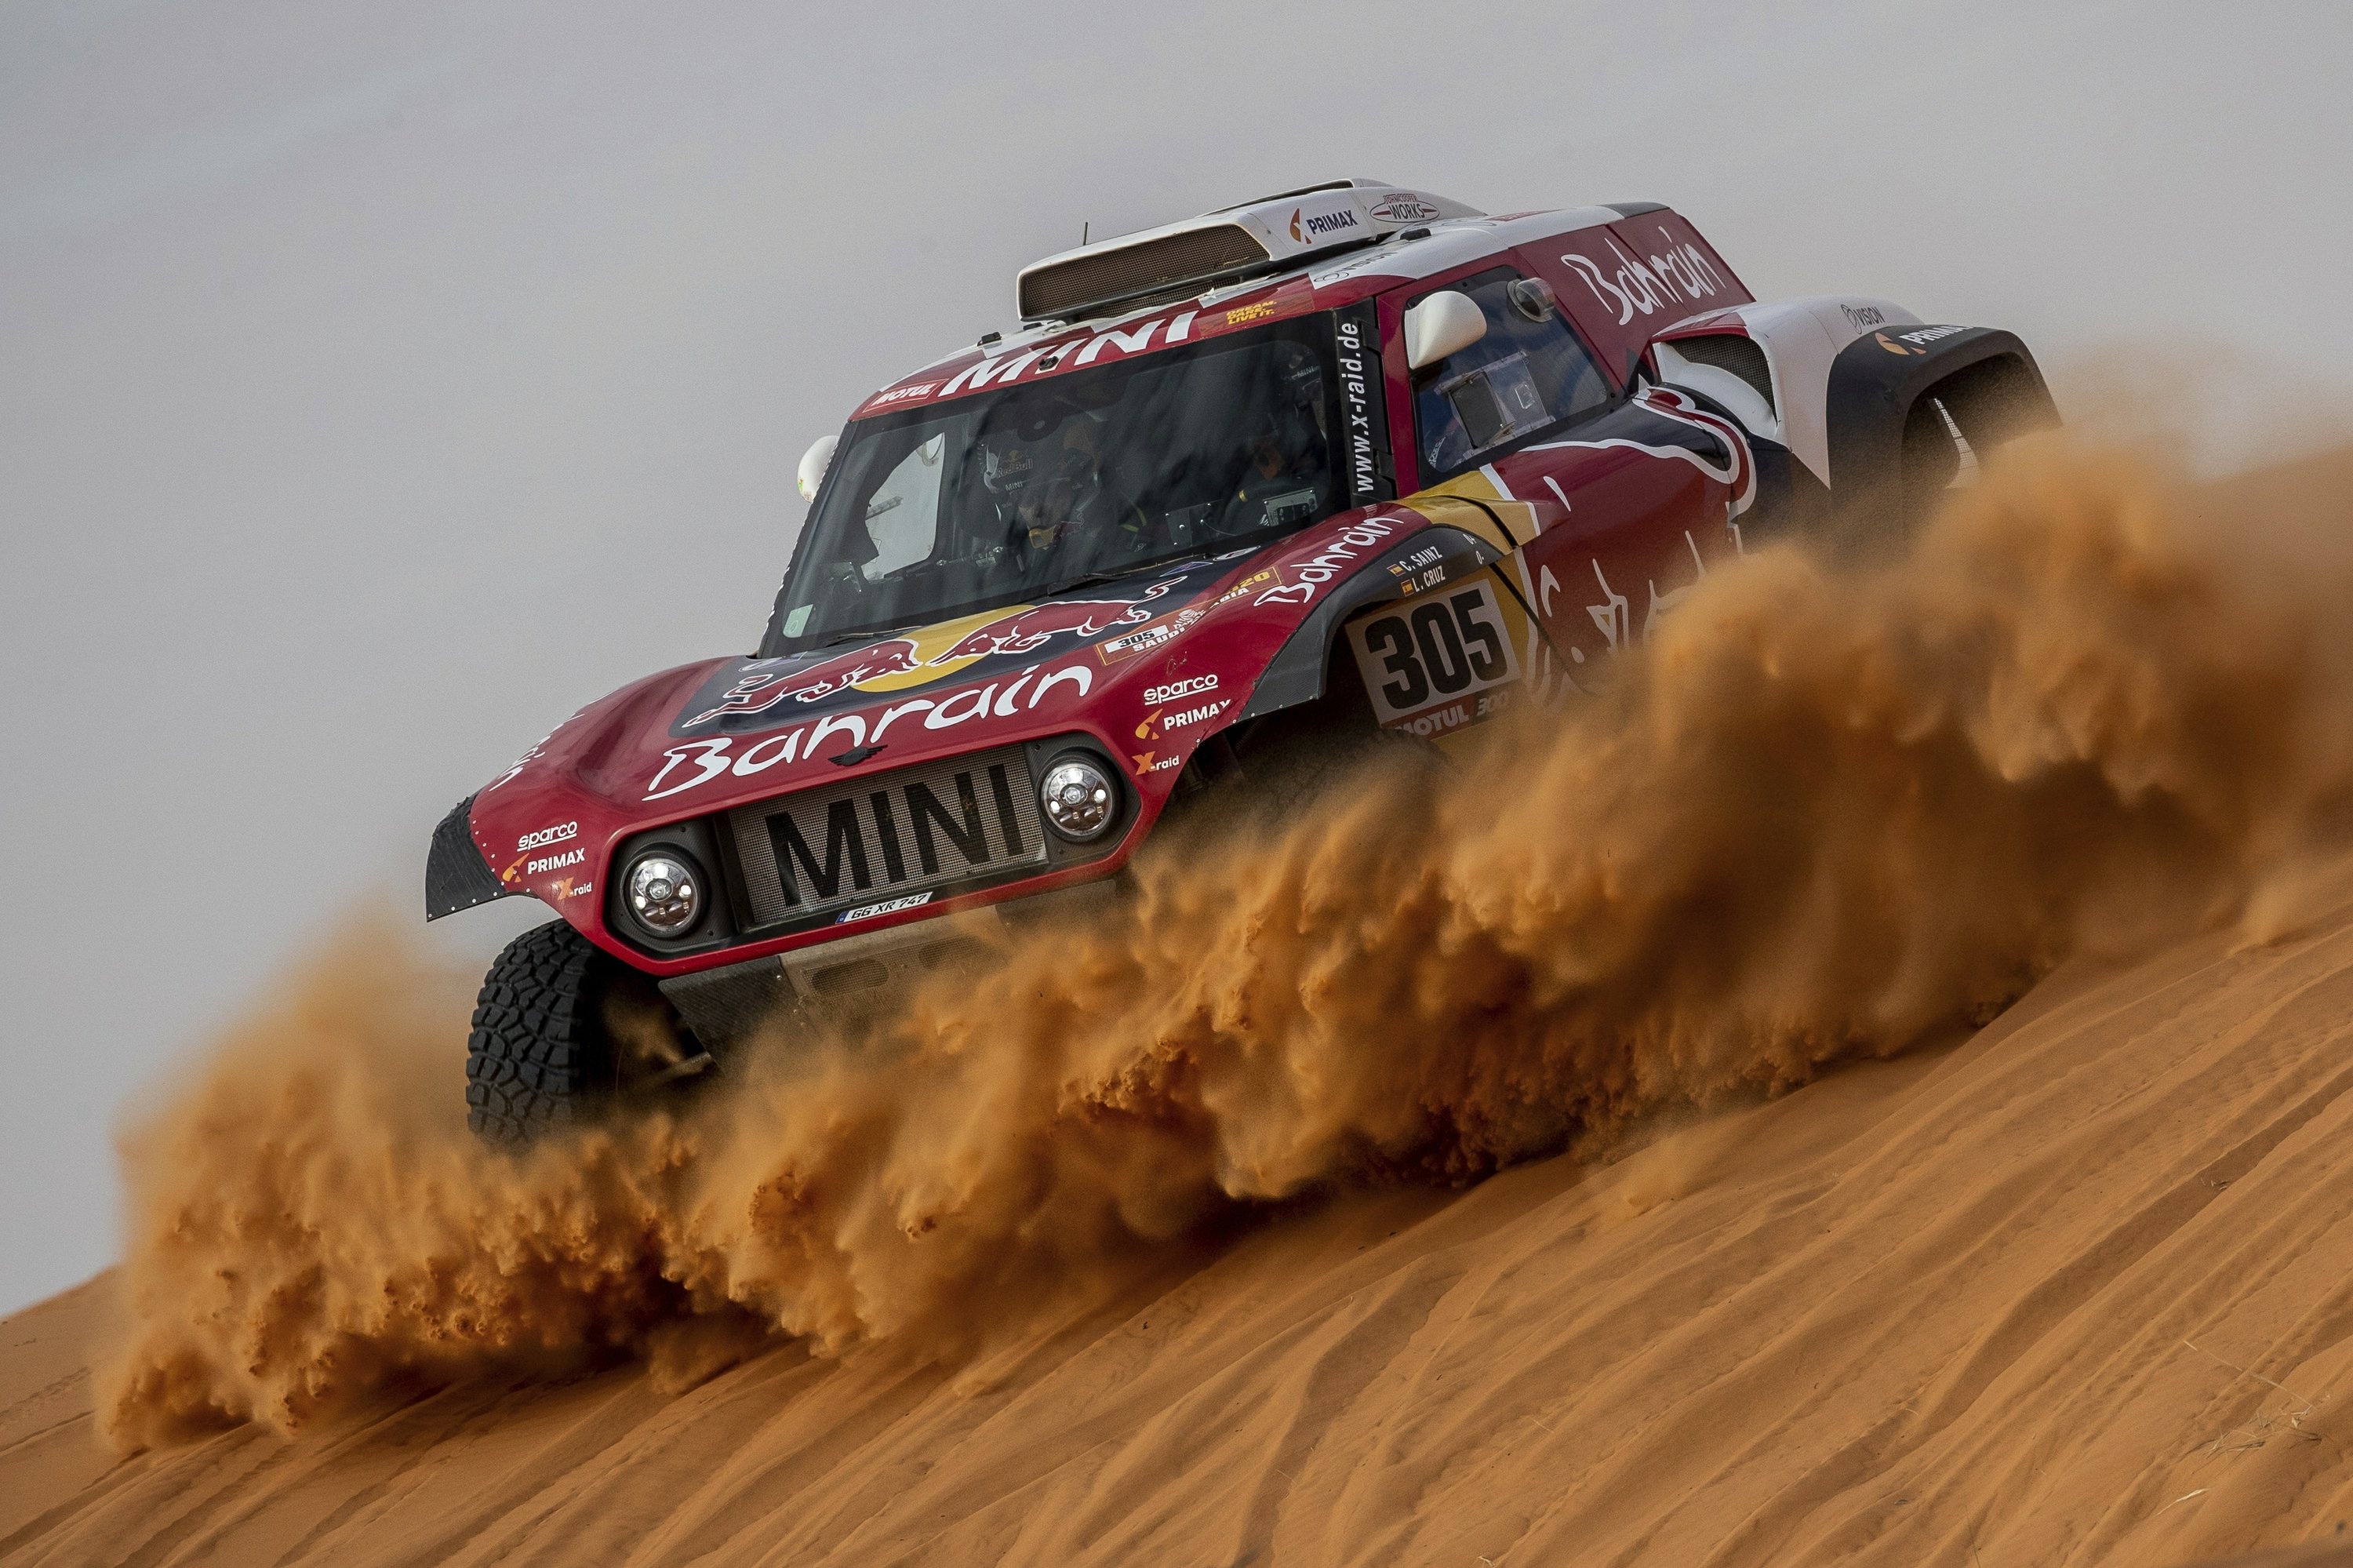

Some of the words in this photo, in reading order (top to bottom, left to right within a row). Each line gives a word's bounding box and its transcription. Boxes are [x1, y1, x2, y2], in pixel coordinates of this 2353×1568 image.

[1306, 209, 1358, 235] PRIMAX
[1387, 203, 1425, 220] WORKS
[1560, 225, 1727, 326] Bahrain
[1228, 313, 1257, 325] LIVE
[1853, 306, 1886, 326] VISION
[938, 310, 1199, 397] MINI
[871, 380, 939, 407] MOTUL
[1337, 322, 1374, 492] www.x-raid.de
[1005, 480, 1024, 492] MINI
[1253, 516, 1405, 607] Bahrain
[1398, 560, 1415, 572] C.
[1410, 545, 1443, 568] SAINZ
[1424, 565, 1446, 587] CRUZ
[1118, 630, 1155, 648] 305
[1132, 627, 1185, 653] SAUDI
[1364, 587, 1510, 710] 305
[1144, 674, 1219, 706] sparco
[642, 664, 1093, 802] Bahrain
[517, 820, 578, 853] sparco
[765, 763, 1024, 907] MINI
[527, 847, 586, 875] PRIMAX
[851, 907, 873, 919] GG
[875, 901, 896, 914] XR
[899, 894, 927, 908] 747
